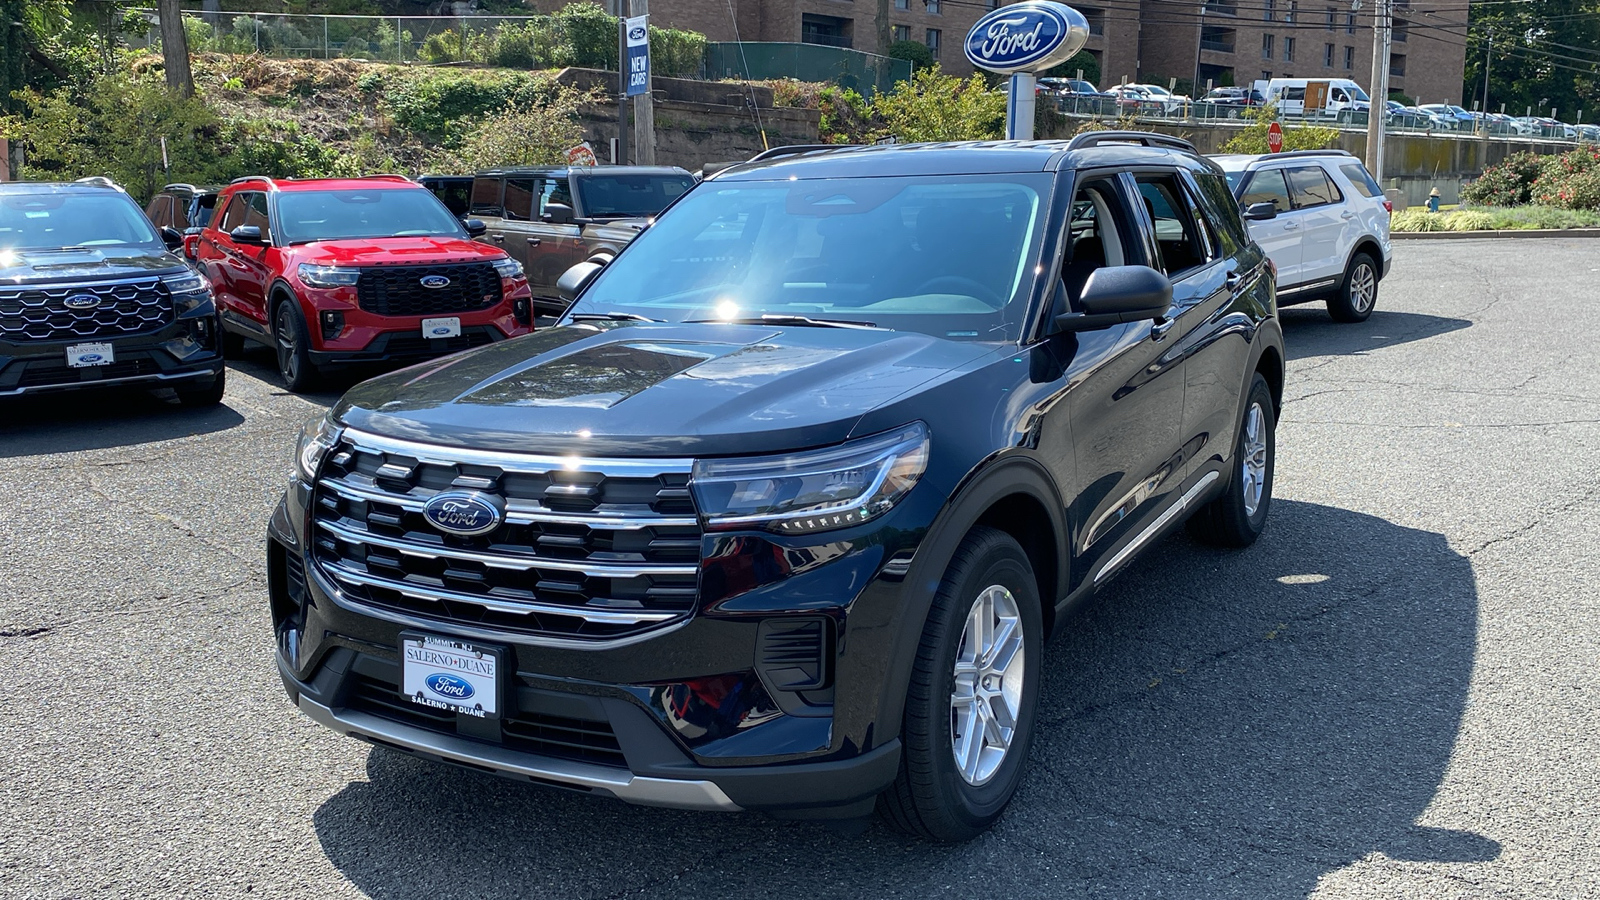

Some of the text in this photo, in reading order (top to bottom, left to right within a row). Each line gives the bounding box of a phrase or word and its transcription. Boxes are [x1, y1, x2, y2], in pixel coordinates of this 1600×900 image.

[981, 16, 1043, 59] Ford
[631, 56, 646, 73] NEW
[631, 72, 646, 86] CARS
[1270, 132, 1281, 145] STOP
[73, 297, 92, 305] Ford
[438, 501, 479, 526] Ford
[461, 643, 473, 652] NJ
[407, 648, 494, 676] SALERNO DUANE
[435, 676, 466, 697] Ford
[411, 696, 486, 718] SALERNO DUANE
